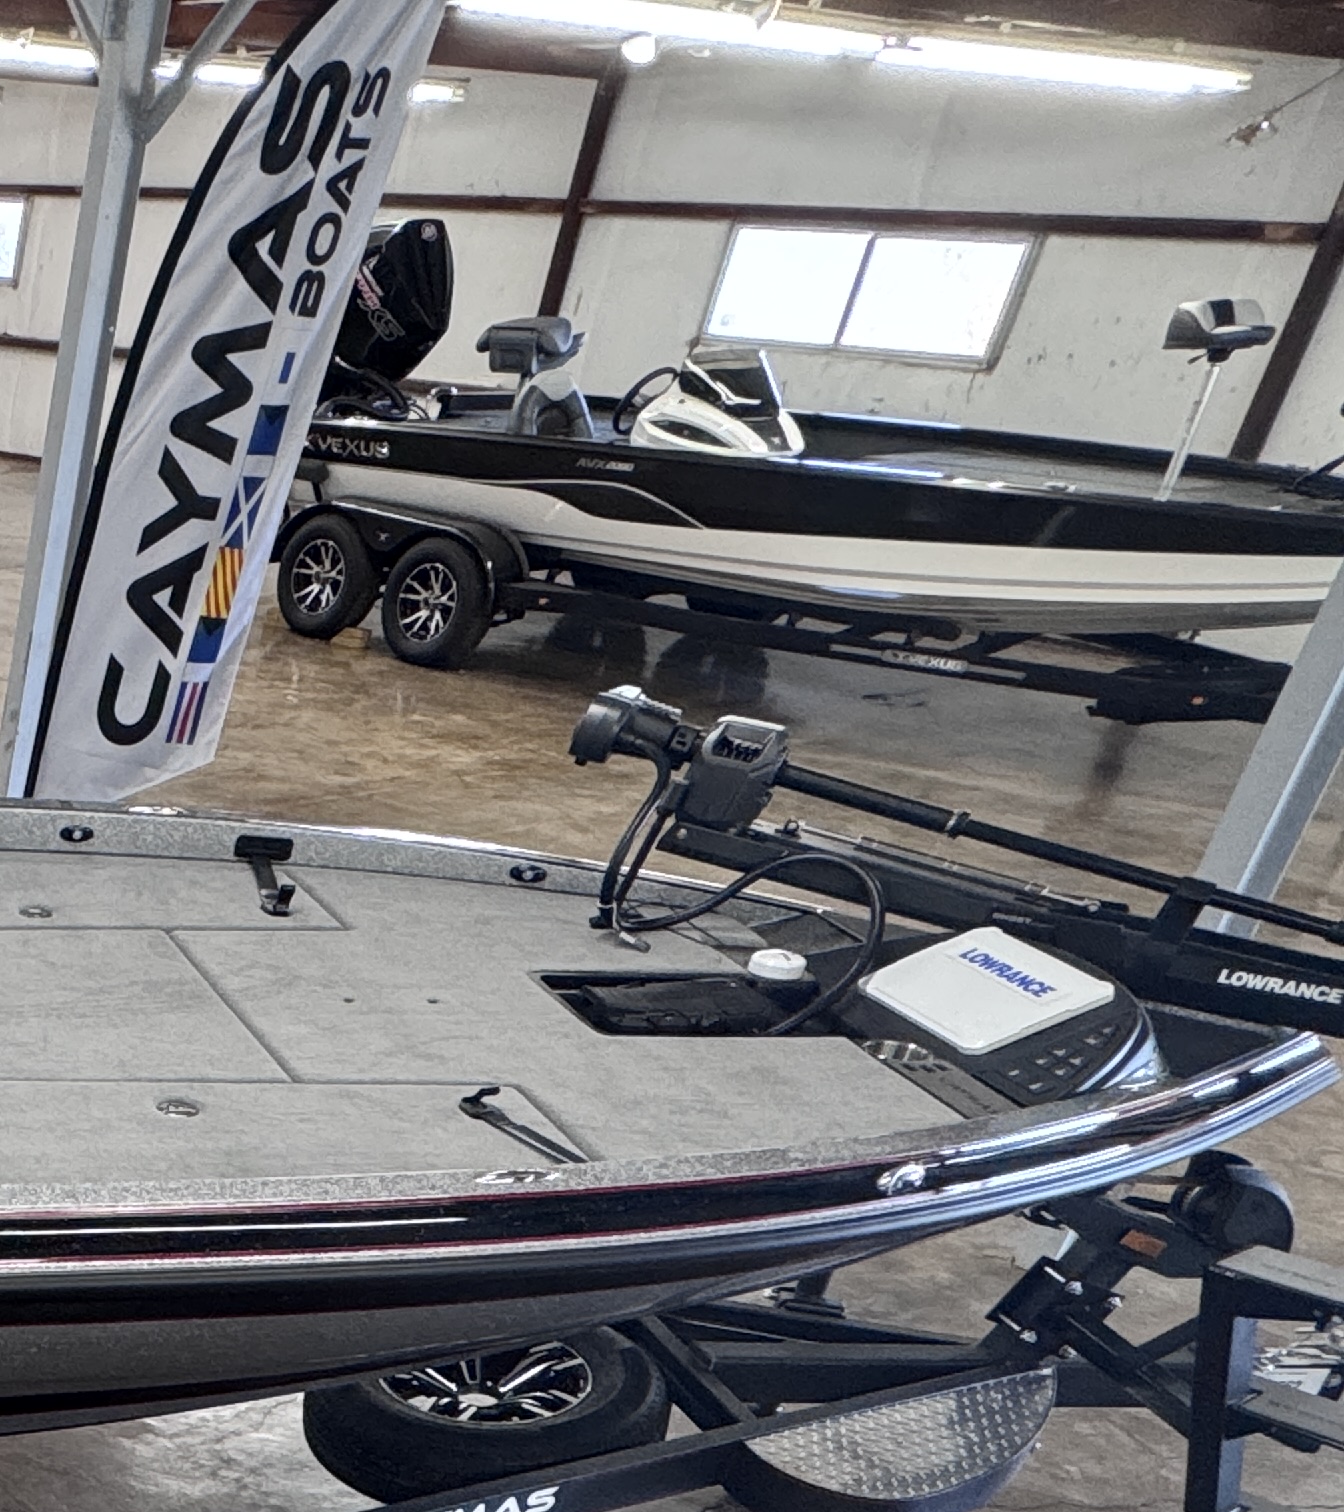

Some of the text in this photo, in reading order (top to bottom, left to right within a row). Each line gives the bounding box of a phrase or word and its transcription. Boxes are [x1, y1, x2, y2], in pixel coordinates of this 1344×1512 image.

[289, 65, 392, 318] BOATS
[97, 59, 351, 746] CAYMAS
[318, 434, 390, 459] VEXUS
[958, 946, 1058, 999] LOWRANCE
[1216, 967, 1343, 1005] LOWRANCE
